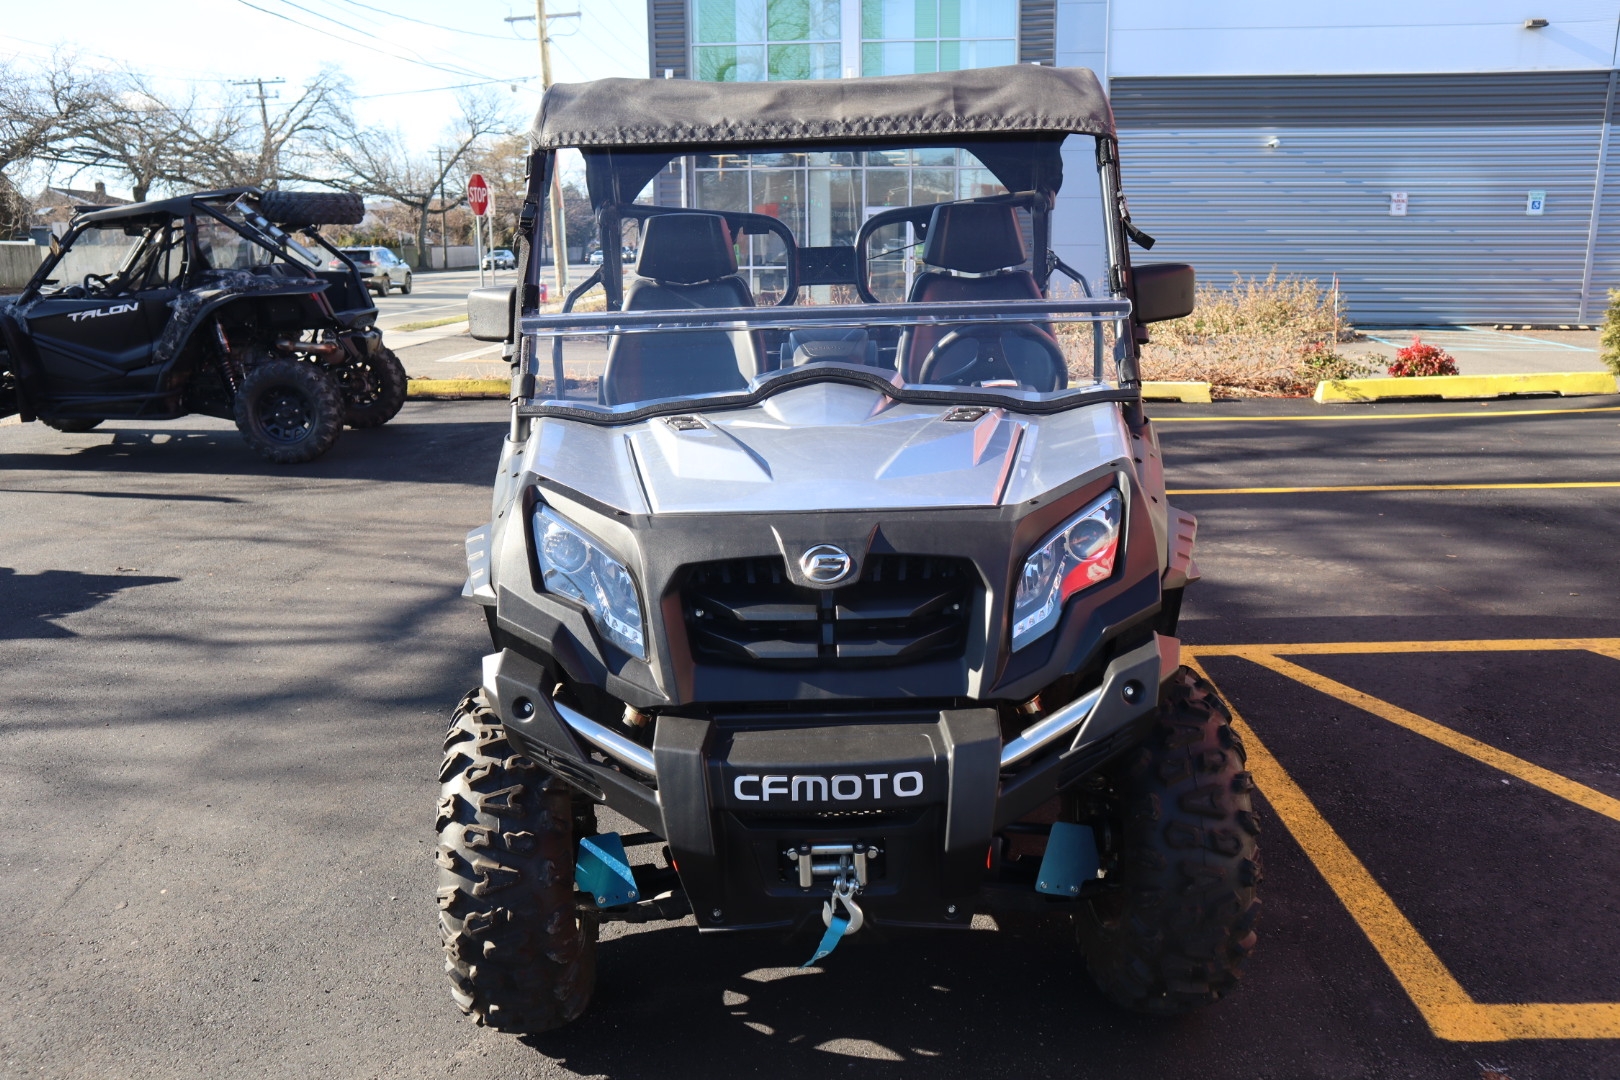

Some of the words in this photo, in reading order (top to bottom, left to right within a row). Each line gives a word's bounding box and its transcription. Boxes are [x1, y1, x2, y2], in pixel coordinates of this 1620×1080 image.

[469, 186, 487, 203] STOP
[67, 302, 139, 322] TALON
[733, 771, 924, 802] CFMOTO
